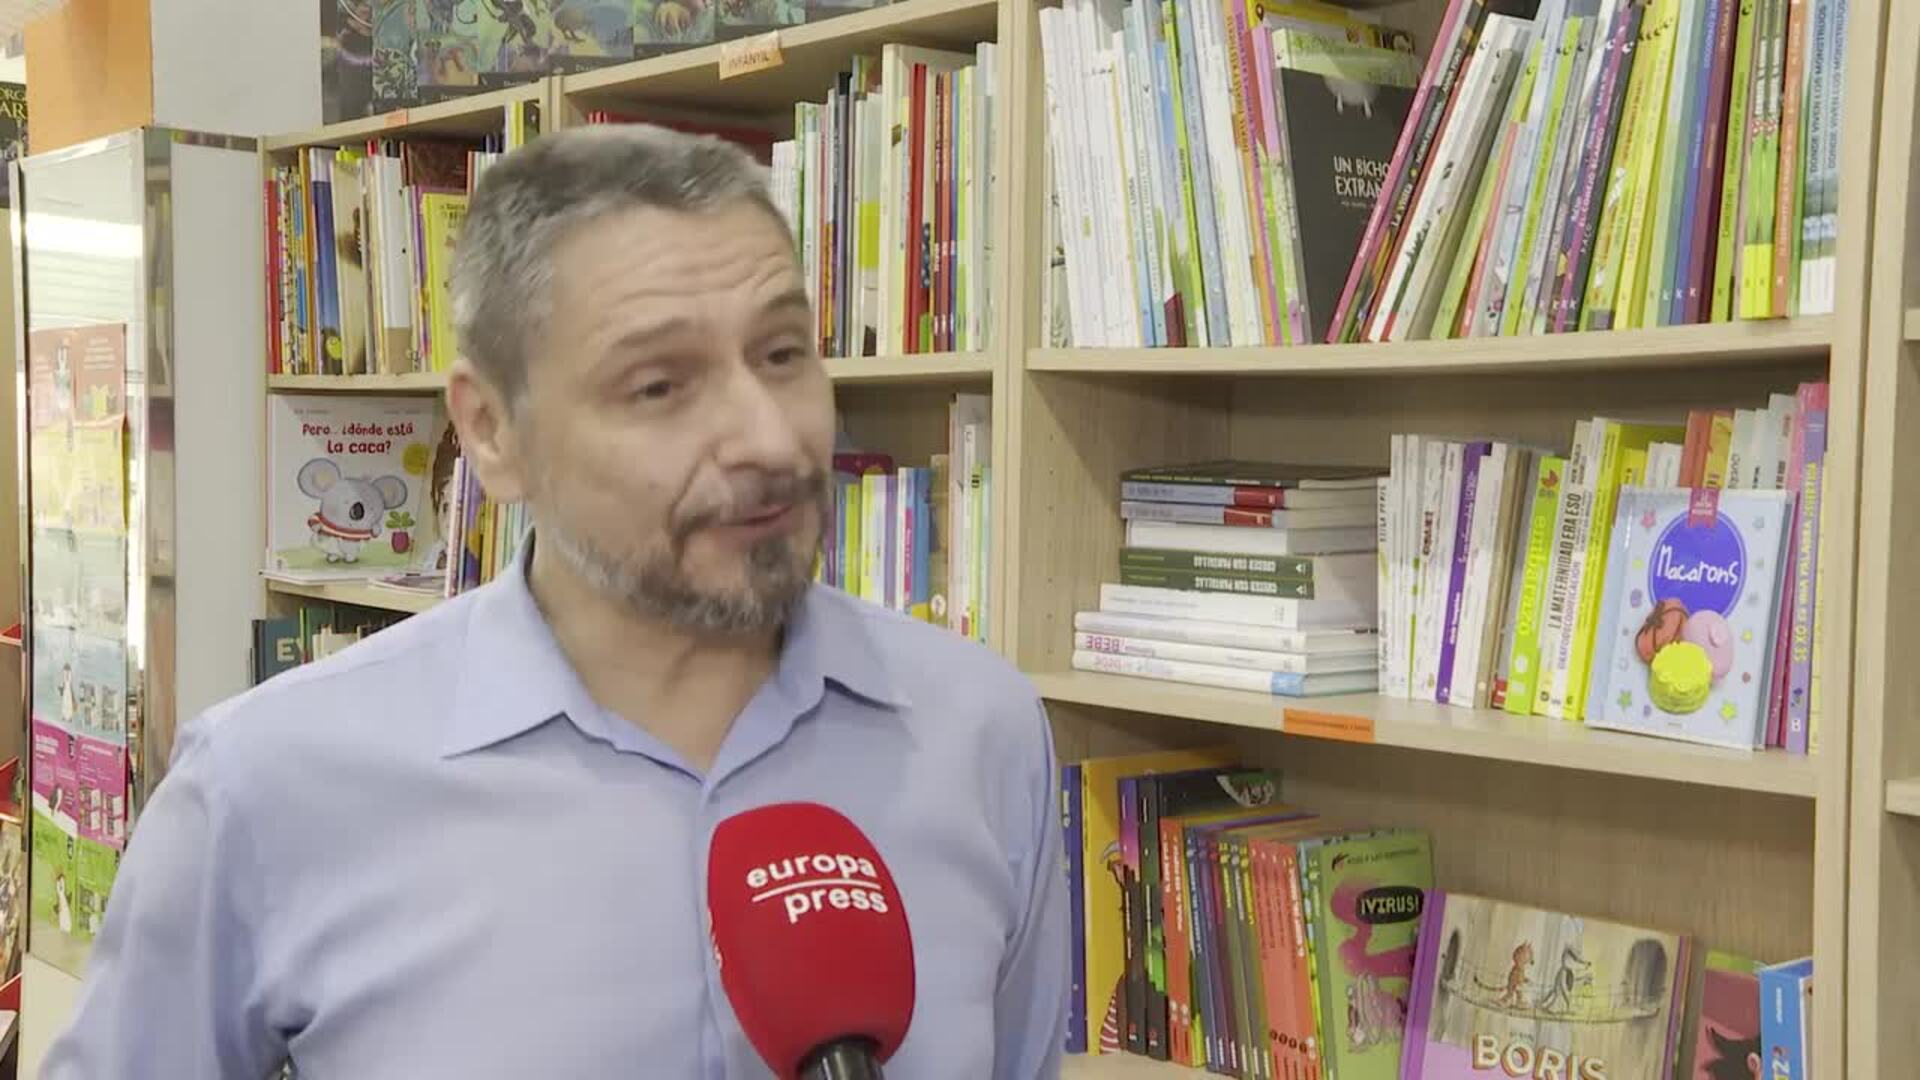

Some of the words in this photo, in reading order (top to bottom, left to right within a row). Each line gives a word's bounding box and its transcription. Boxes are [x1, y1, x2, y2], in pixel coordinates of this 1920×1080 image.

[1333, 155, 1352, 173] UN
[387, 422, 414, 436] está
[349, 440, 391, 455] caca?
[1566, 492, 1581, 515] ESO
[1562, 517, 1578, 540] ERA
[1550, 540, 1574, 612] MATERNIDAD
[1656, 543, 1739, 586] Macarons
[1548, 614, 1562, 628] LA
[746, 853, 878, 888] europa
[784, 889, 888, 924] press
[1472, 1033, 1606, 1080] BORIS
